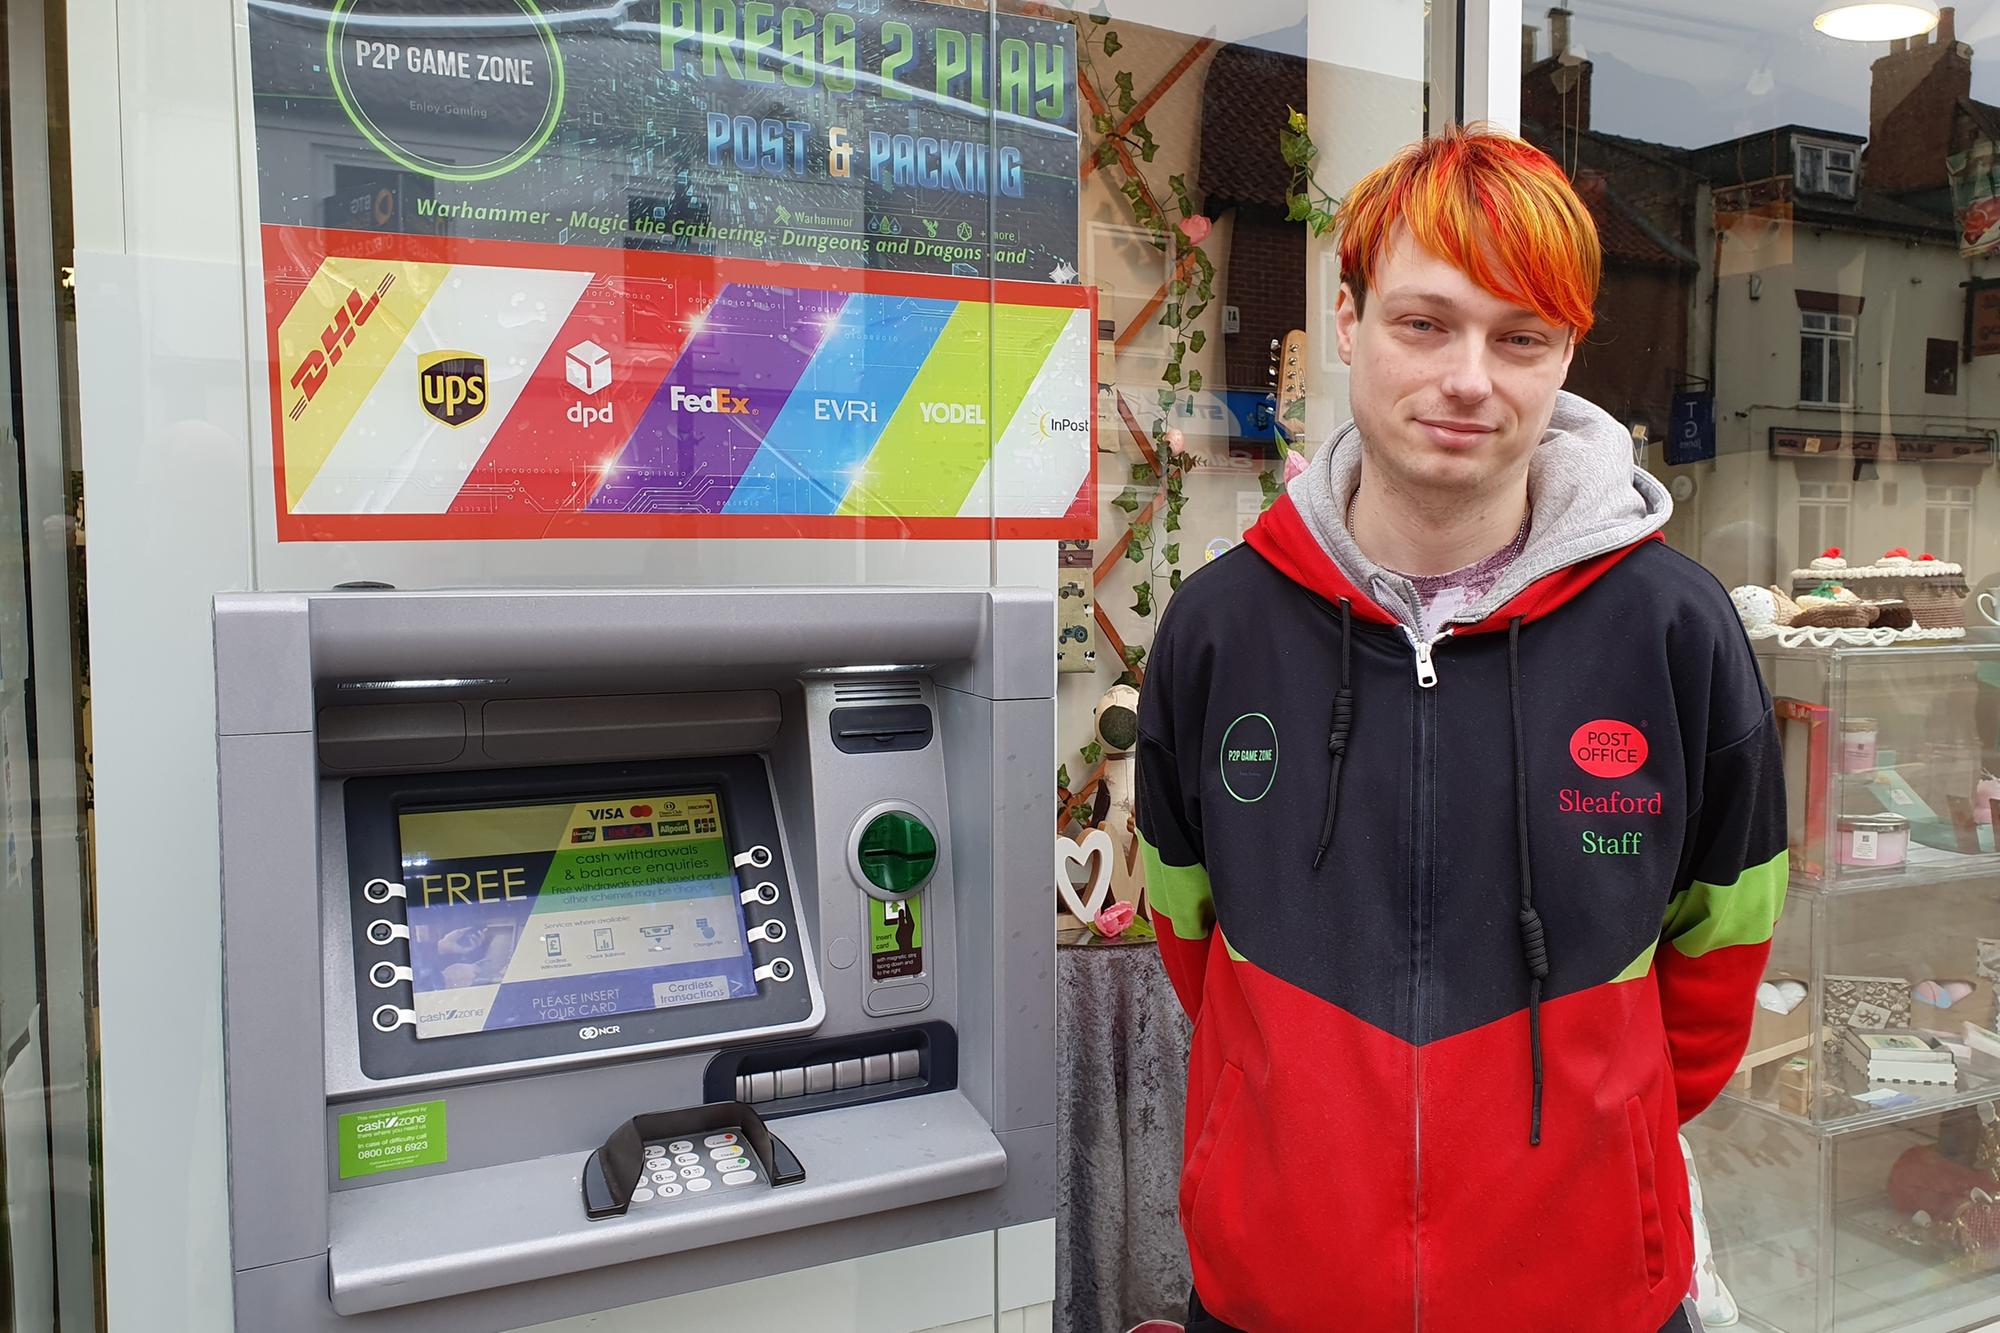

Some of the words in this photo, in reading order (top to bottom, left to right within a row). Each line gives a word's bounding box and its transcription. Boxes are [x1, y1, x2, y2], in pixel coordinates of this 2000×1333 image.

[356, 39, 400, 70] P2P
[407, 47, 470, 79] GAME
[477, 54, 534, 86] ZONE
[659, 0, 857, 93] PRESS
[881, 21, 915, 99] 2
[935, 27, 1065, 119] PLAY
[707, 112, 811, 175] POST
[829, 126, 854, 178] &
[416, 198, 550, 226] Warhammer
[569, 210, 627, 234] Magic
[634, 218, 666, 236] the
[671, 220, 765, 247] Gathering
[783, 230, 869, 256] Dungeons
[876, 236, 909, 257] and
[914, 241, 981, 264] Dragons
[995, 248, 1027, 264] and
[290, 287, 380, 401] DHL
[424, 374, 484, 417] ups
[670, 385, 751, 414] FedEx
[567, 402, 614, 428] dpd
[920, 402, 986, 425] YODEL
[1050, 416, 1089, 433] InPost
[1588, 731, 1632, 747] POST
[1228, 749, 1240, 761] P2P
[1241, 749, 1258, 761] GAME
[1258, 749, 1273, 761] ZONE
[1577, 747, 1638, 763] OFFICE
[1559, 788, 1662, 815] Sleaford
[587, 808, 624, 821] VISA
[660, 824, 688, 834] Allpoint
[1582, 830, 1643, 855] Staff
[575, 851, 611, 865] cash
[613, 845, 699, 861] withdrawals
[564, 870, 575, 881] &
[580, 863, 641, 879] balance
[646, 858, 710, 874] enquiries
[421, 866, 527, 909] FREE
[660, 987, 726, 1004] transactions
[668, 979, 714, 993] Cardless
[532, 993, 577, 1009] PLEASE
[581, 988, 620, 1002] INSERT
[539, 1004, 576, 1020] YOUR
[578, 1001, 617, 1016] CARD
[599, 1025, 621, 1036] NCR
[358, 1148, 382, 1160] 0800
[384, 1145, 402, 1155] 028
[404, 1141, 428, 1152] 6923
